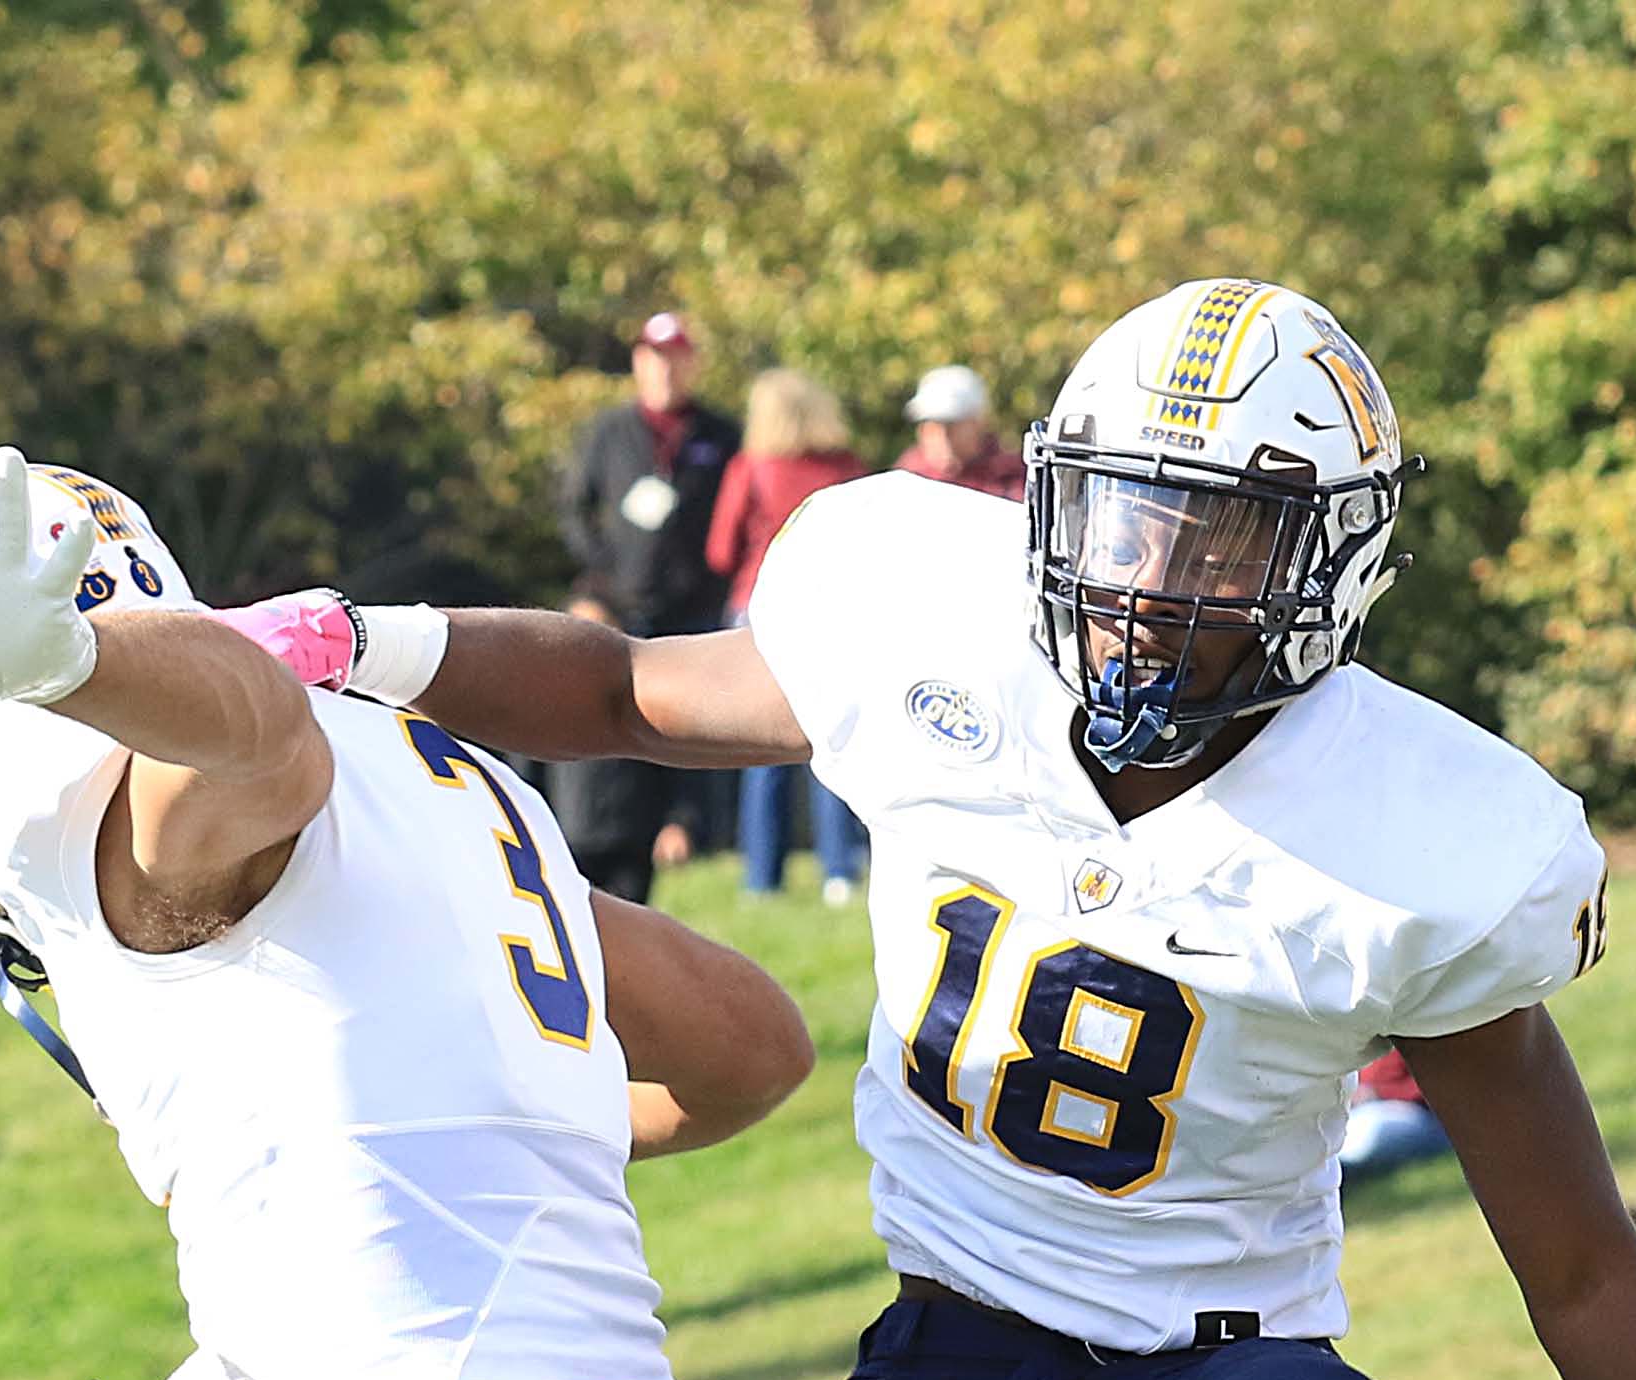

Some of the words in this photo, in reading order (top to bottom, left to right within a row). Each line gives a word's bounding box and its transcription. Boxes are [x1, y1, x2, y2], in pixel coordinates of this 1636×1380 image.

[1139, 426, 1206, 450] SPEED
[396, 712, 596, 1052] 3
[902, 883, 1206, 1196] 18
[1220, 1319, 1235, 1340] L
